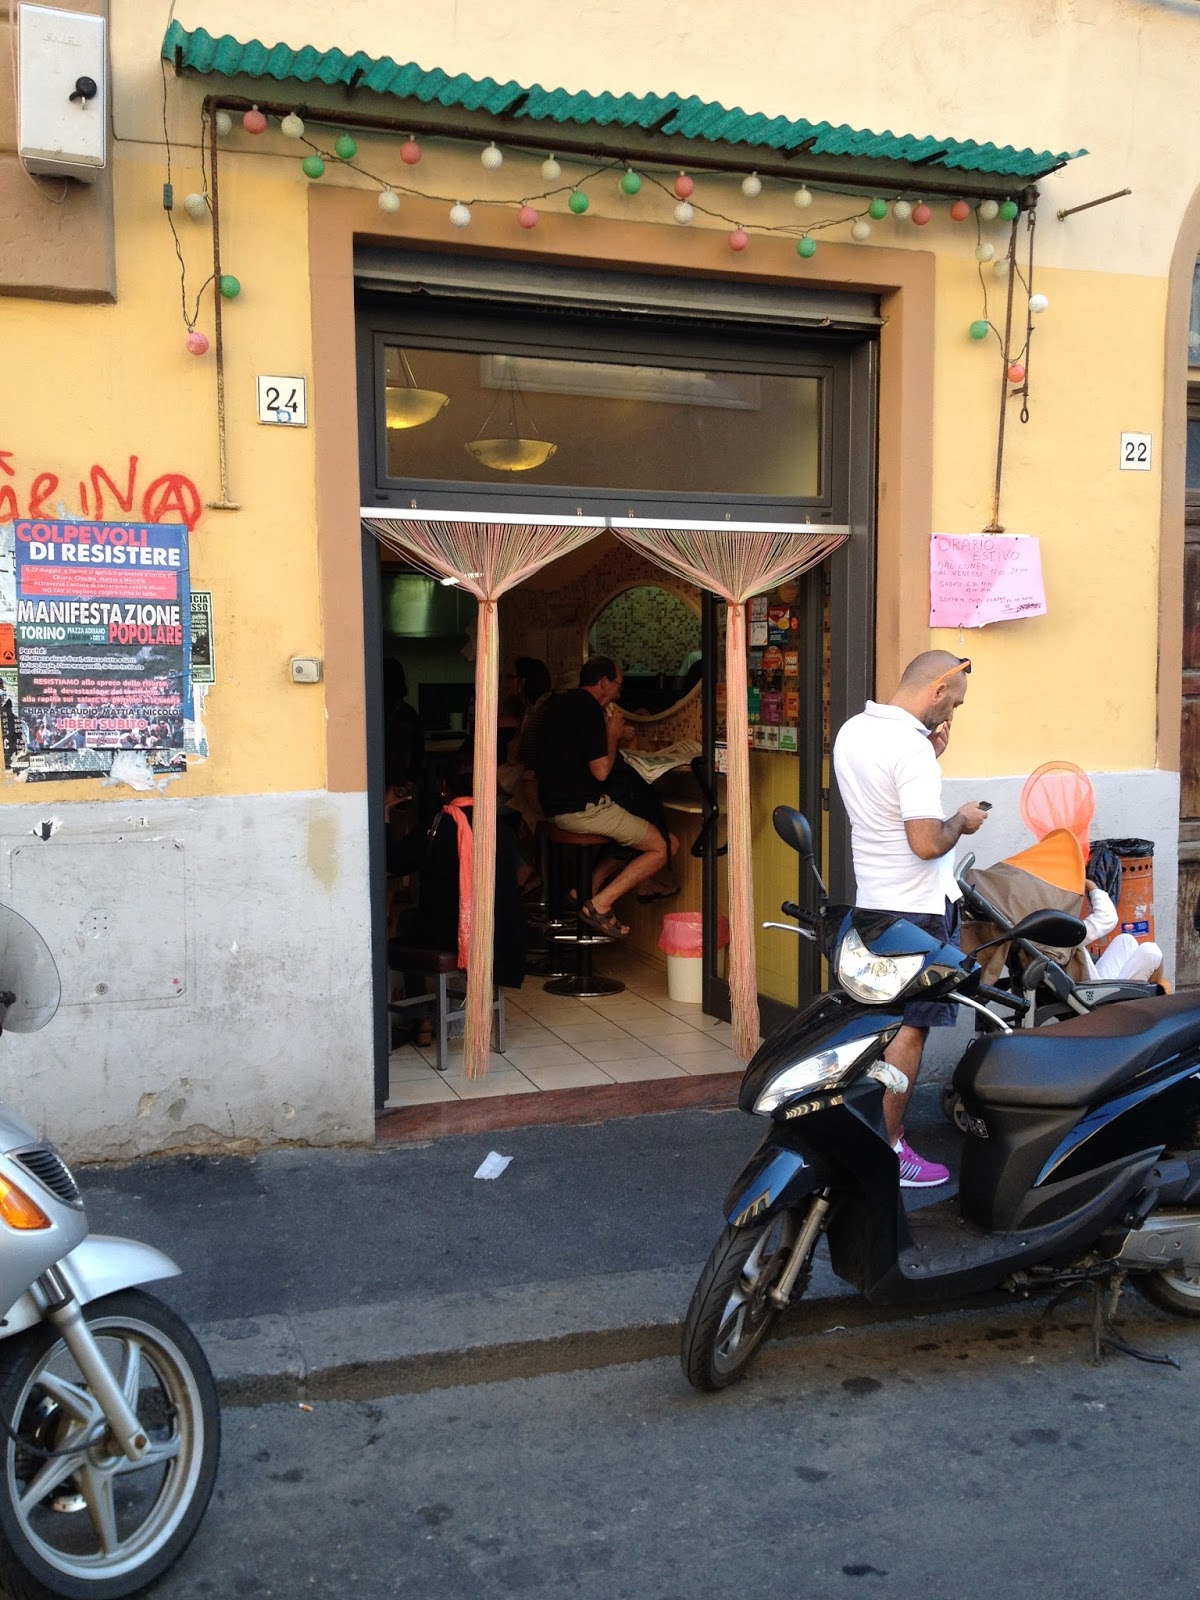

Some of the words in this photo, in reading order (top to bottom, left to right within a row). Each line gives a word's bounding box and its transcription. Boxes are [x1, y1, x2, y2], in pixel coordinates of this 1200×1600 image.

[266, 387, 298, 412] 24
[1126, 442, 1146, 461] 22
[16, 523, 148, 546] COLPEVOLI
[938, 538, 994, 551] ORARIO
[30, 542, 54, 560] DI
[62, 543, 180, 566] RESISTERE
[972, 550, 1020, 562] ESTIVO
[18, 600, 180, 626] MANIFESTAZIONE
[20, 626, 65, 640] TORINO
[109, 623, 182, 645] POPOLARE
[57, 718, 97, 729] LIBERI
[100, 718, 148, 730] SUBITO
